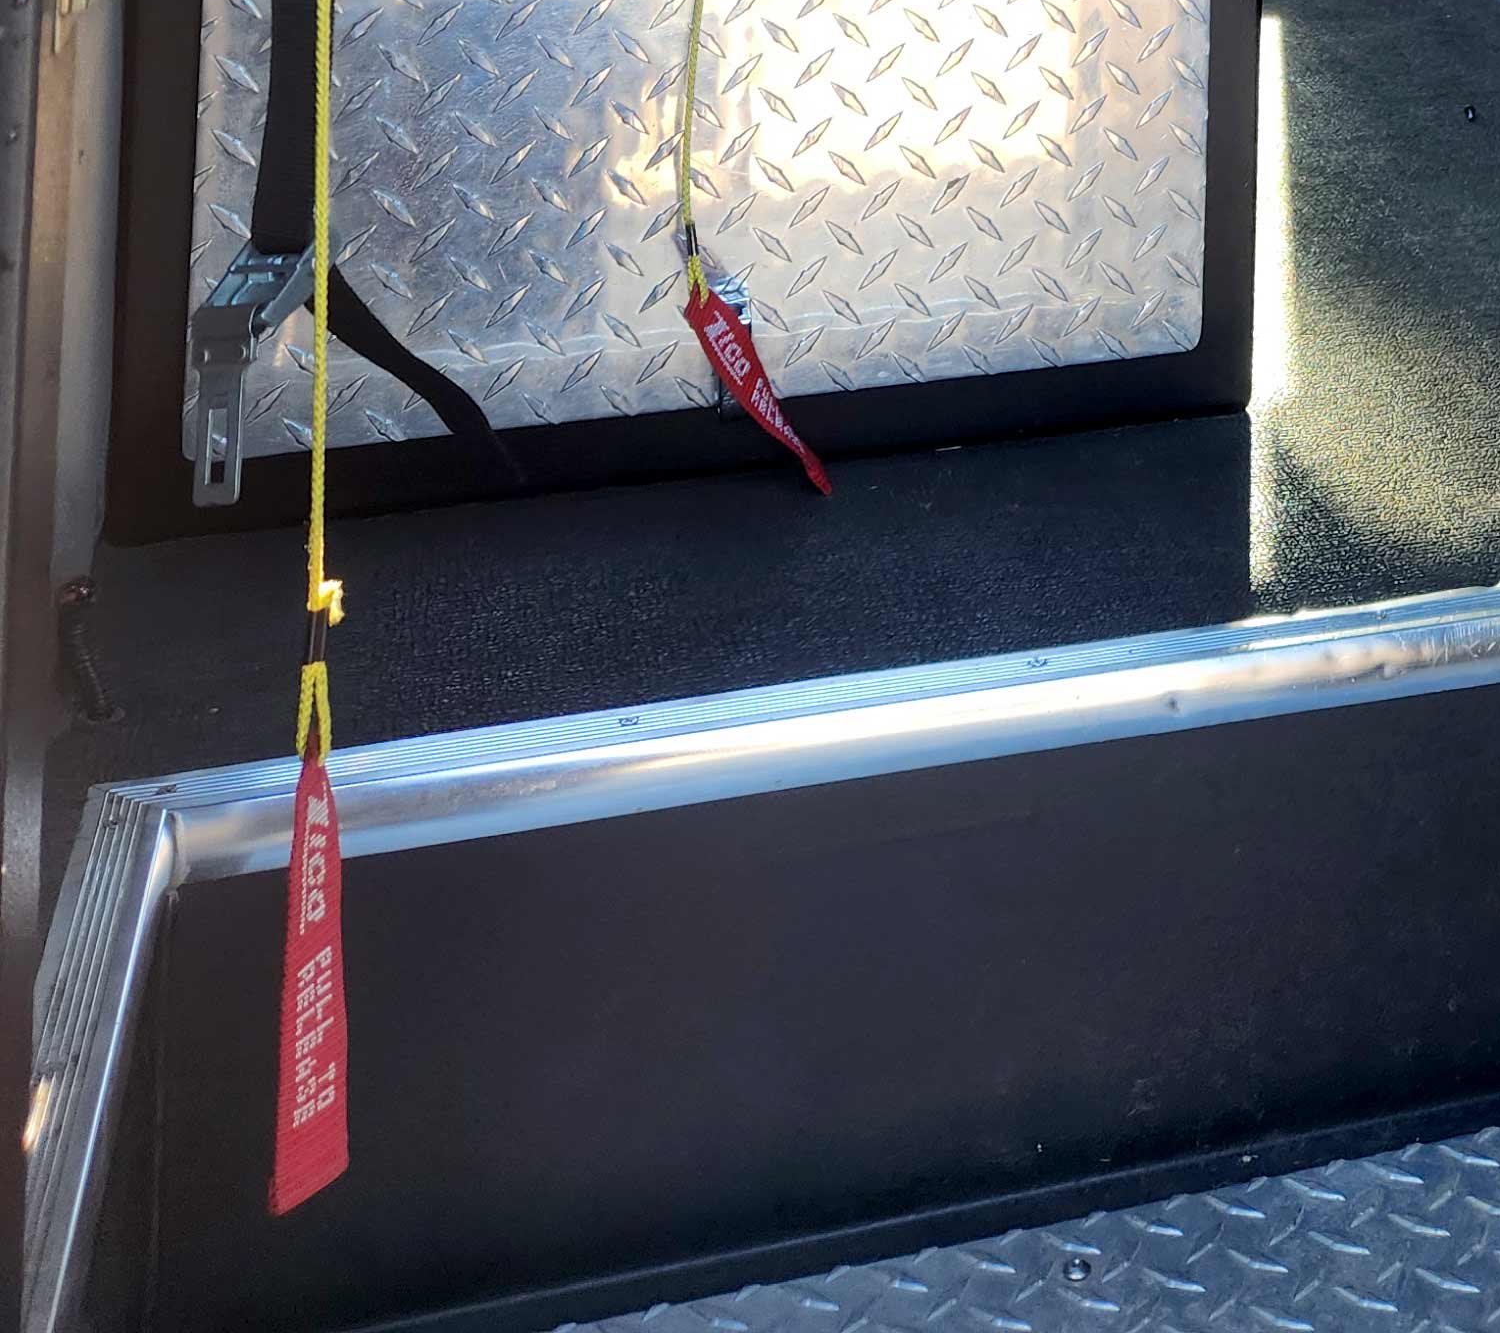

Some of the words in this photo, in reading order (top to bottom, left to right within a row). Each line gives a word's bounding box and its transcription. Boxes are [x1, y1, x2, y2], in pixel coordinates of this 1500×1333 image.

[314, 946, 334, 1043] PULL
[292, 959, 316, 1129] RELEASE
[316, 1062, 336, 1112] TO
